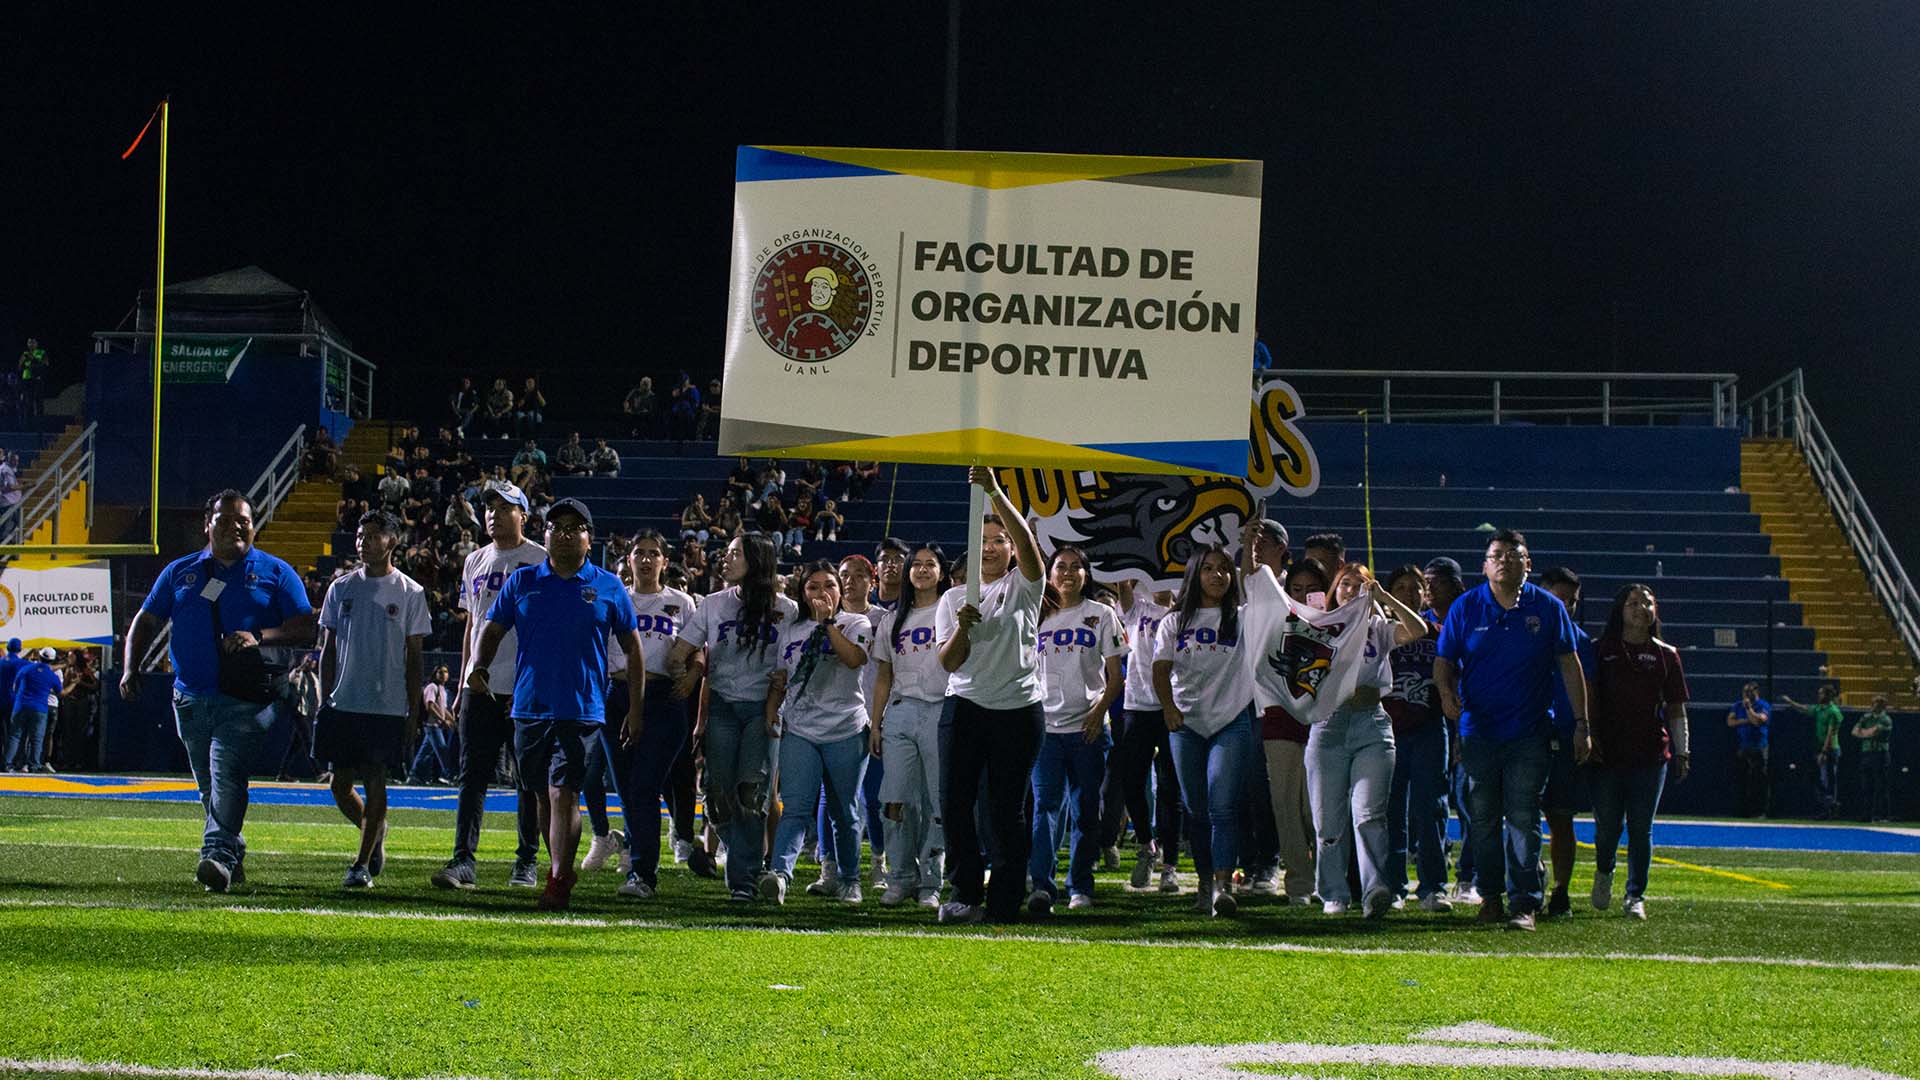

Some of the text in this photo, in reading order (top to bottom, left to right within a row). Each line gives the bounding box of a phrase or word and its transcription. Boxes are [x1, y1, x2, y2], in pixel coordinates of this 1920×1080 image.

[914, 240, 1194, 281] FACULTAD DE
[774, 228, 870, 261] ORGANIZACION
[865, 263, 885, 338] DEPORTIVA
[911, 289, 1241, 334] ORGANIZACIÓN
[171, 344, 230, 357] SALIDA DE
[908, 339, 1149, 380] DEPORTIVA
[783, 362, 830, 375] UANL
[473, 572, 511, 595] FO
[23, 592, 95, 603] FACULTAD DE
[24, 605, 109, 615] ARQUITECTURA
[636, 614, 674, 636] OD
[895, 626, 936, 654] FO
[900, 643, 932, 656] UAN
[1037, 627, 1097, 653] FOD
[1041, 645, 1085, 656] UANL
[1184, 644, 1228, 655] UANL
